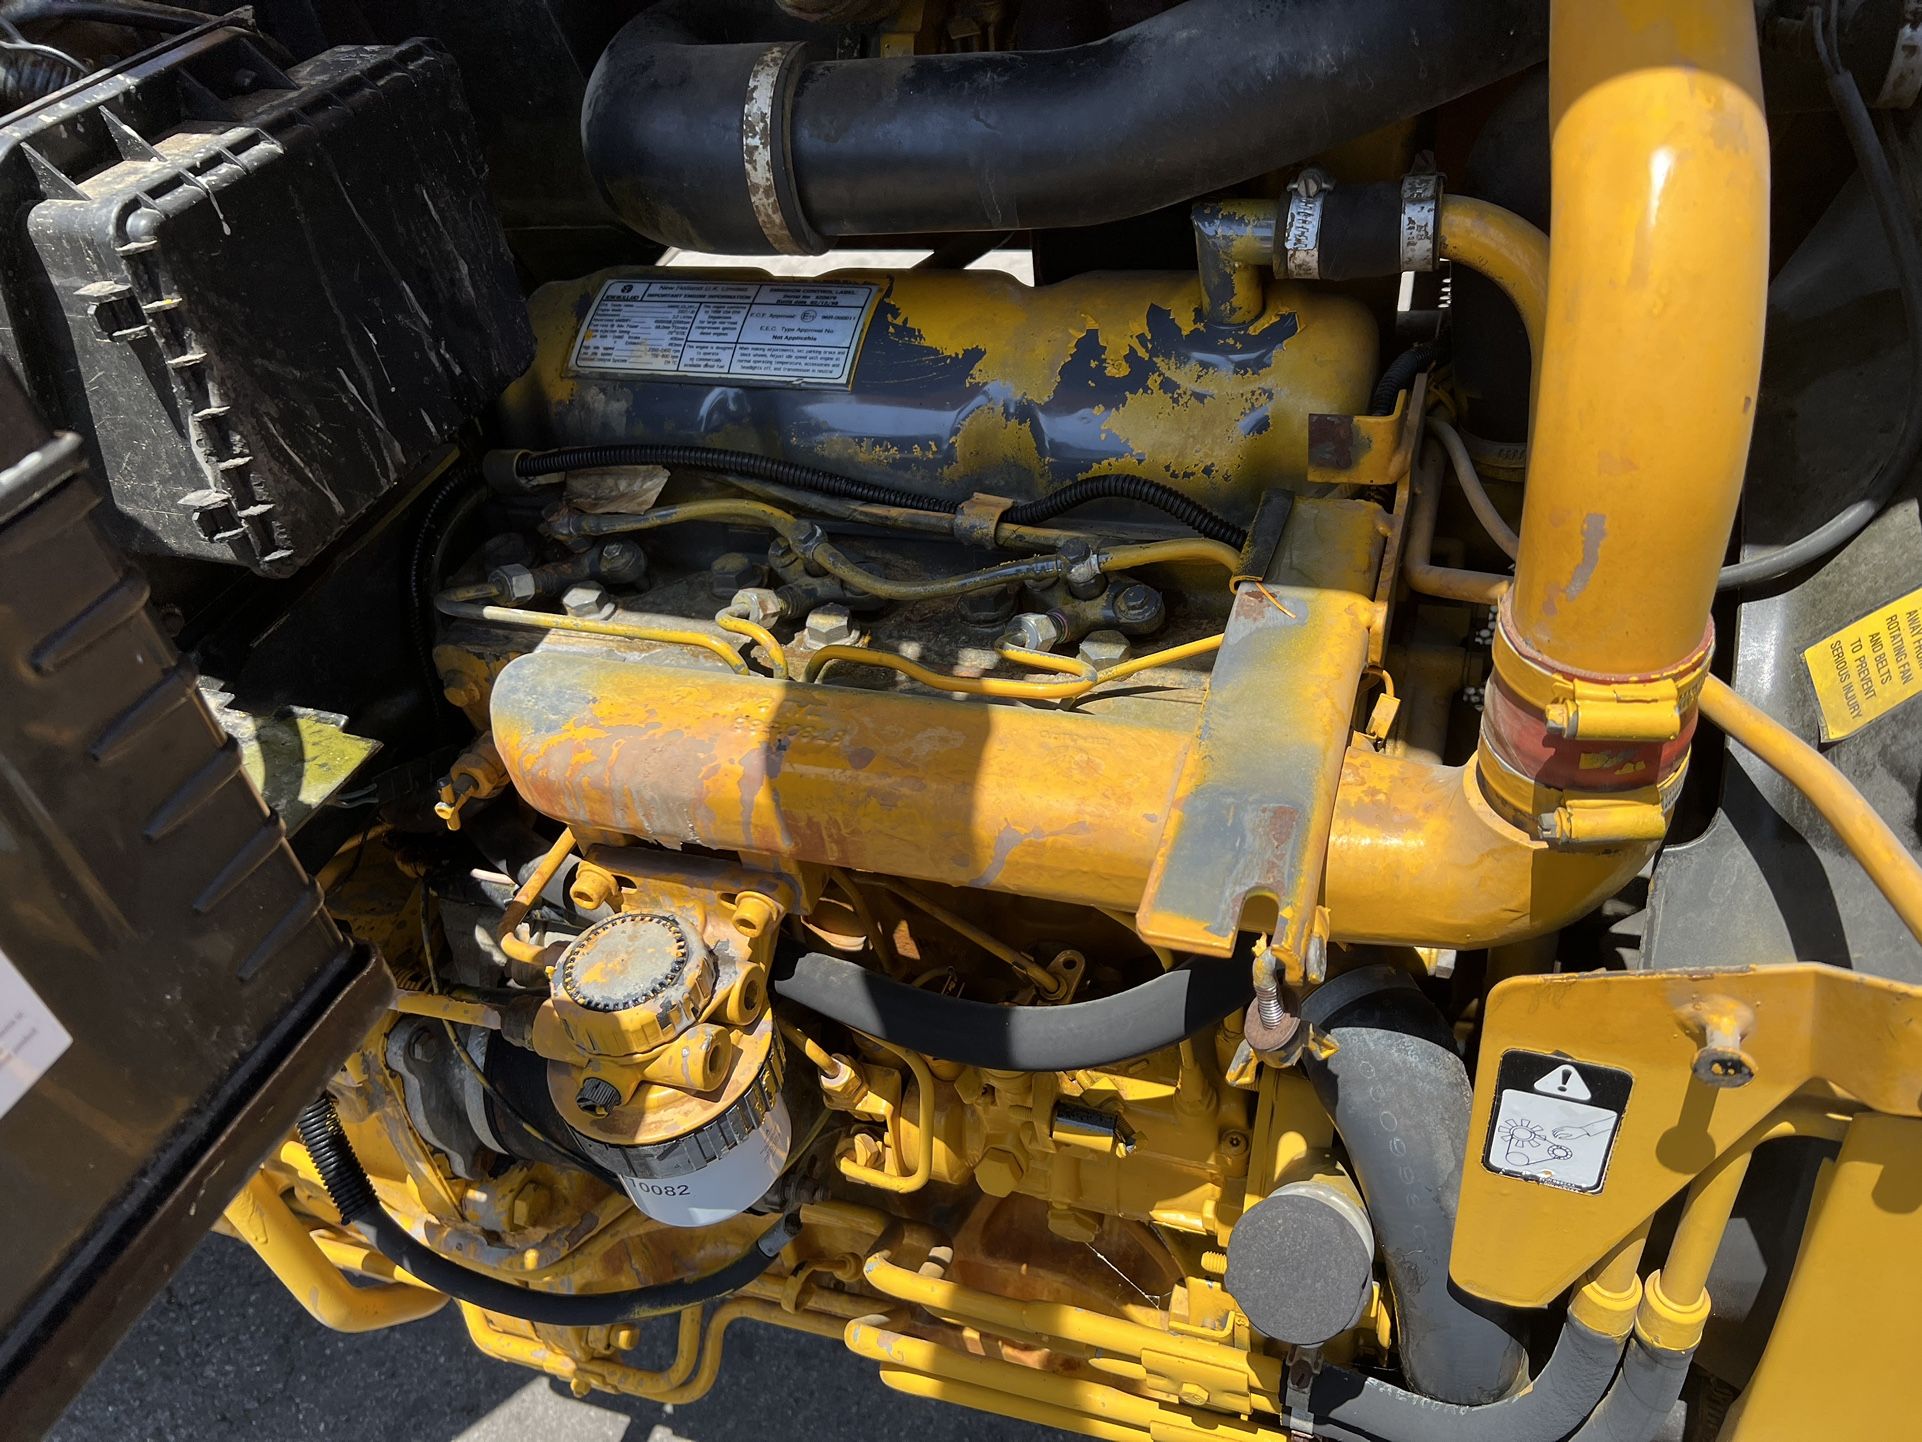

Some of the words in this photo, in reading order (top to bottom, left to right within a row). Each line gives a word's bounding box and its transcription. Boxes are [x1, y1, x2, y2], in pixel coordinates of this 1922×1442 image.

[1850, 638, 1863, 654] TO
[1869, 632, 1884, 653] AND
[1886, 614, 1907, 664] ROTATING
[1898, 661, 1914, 685] FAN
[1830, 640, 1851, 683] SERIOUS
[1843, 682, 1863, 720] INJURY
[1855, 655, 1877, 700] PREVENT
[1875, 652, 1892, 685] BELTS
